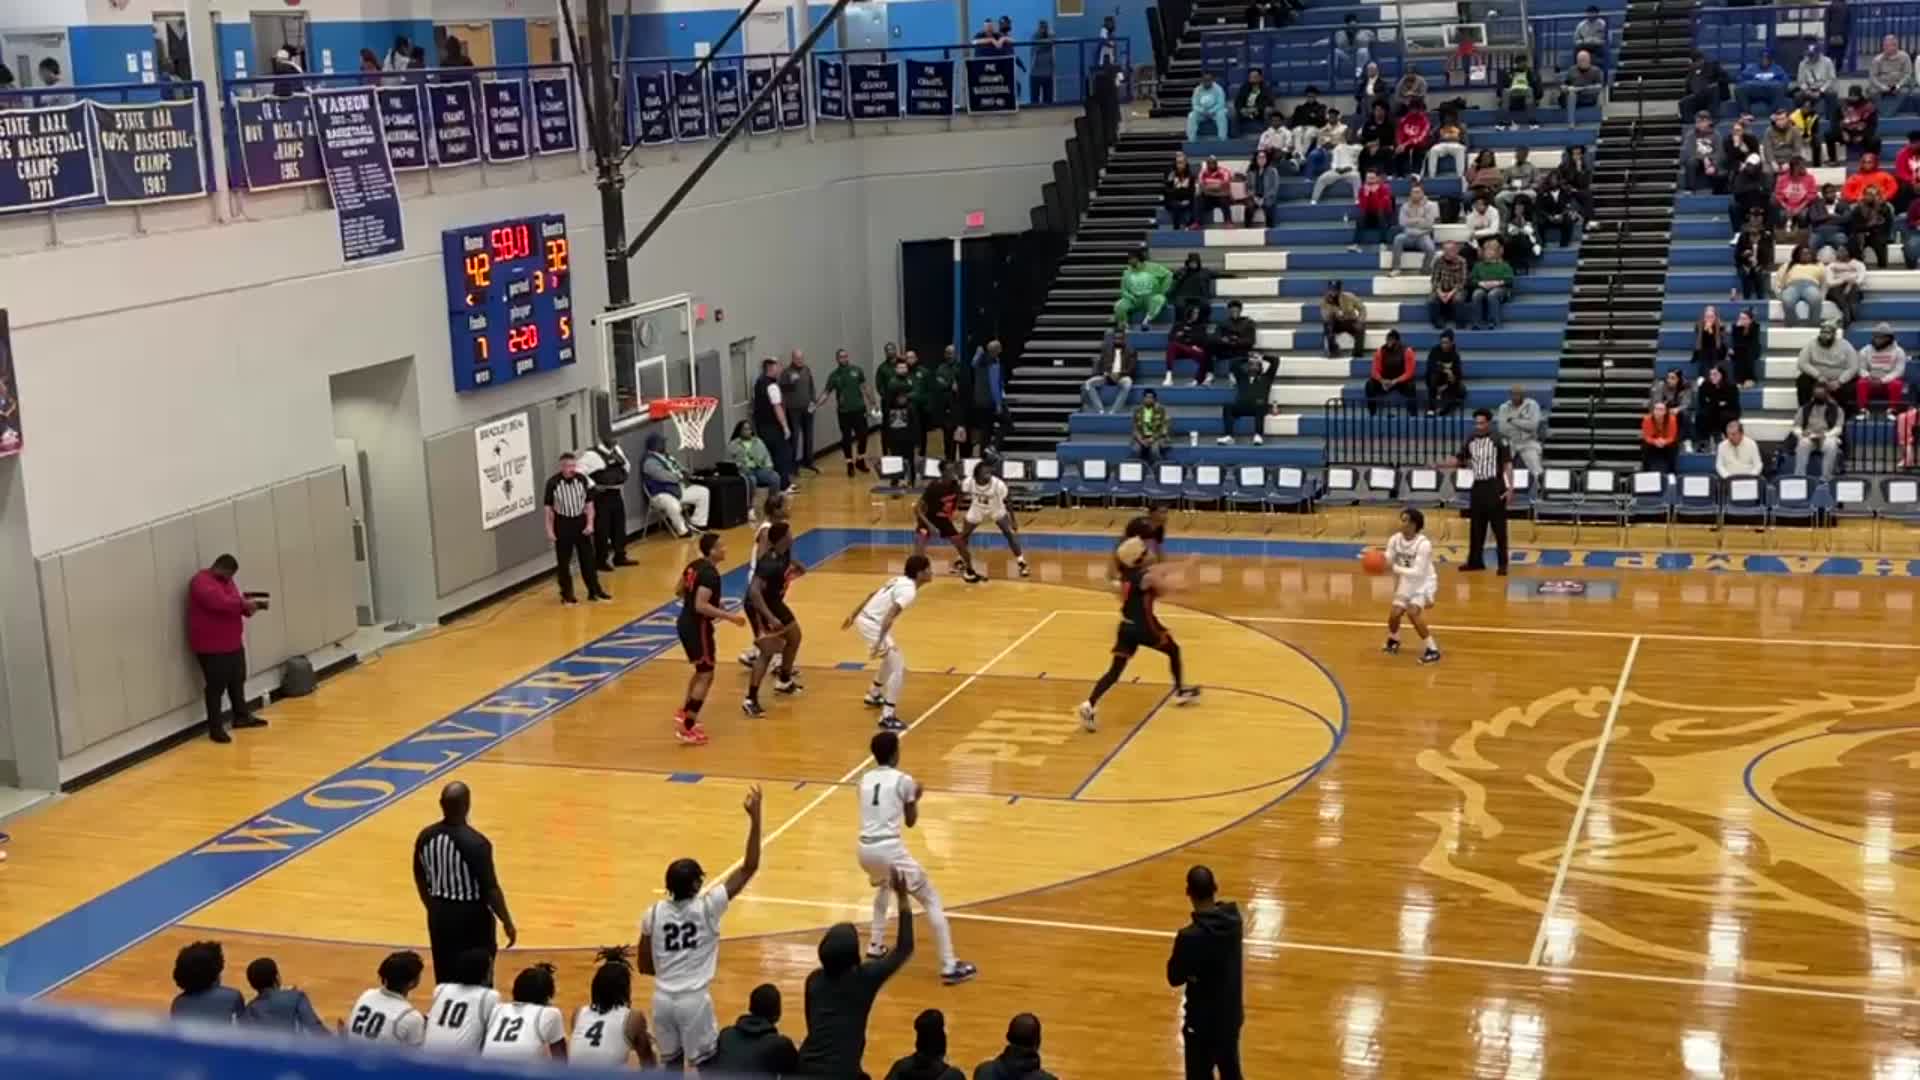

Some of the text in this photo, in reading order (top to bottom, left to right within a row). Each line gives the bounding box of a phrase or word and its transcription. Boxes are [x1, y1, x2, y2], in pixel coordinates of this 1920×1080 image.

[115, 110, 146, 131] STATE
[18, 130, 85, 158] BASKETBALL
[16, 157, 60, 180] CHAMPS
[134, 153, 172, 174] CHAMPS
[28, 178, 55, 201] 1971
[465, 238, 568, 287] 42 32
[533, 270, 545, 294] 3
[476, 337, 489, 360] 7
[558, 316, 571, 340] 5
[1356, 545, 1913, 576] HAMPION
[192, 596, 743, 858] WOLVERINE
[662, 921, 699, 952] 22
[351, 1004, 386, 1040] 20
[437, 998, 468, 1029] 10
[491, 1015, 524, 1043] 12
[584, 1019, 607, 1047] 4
